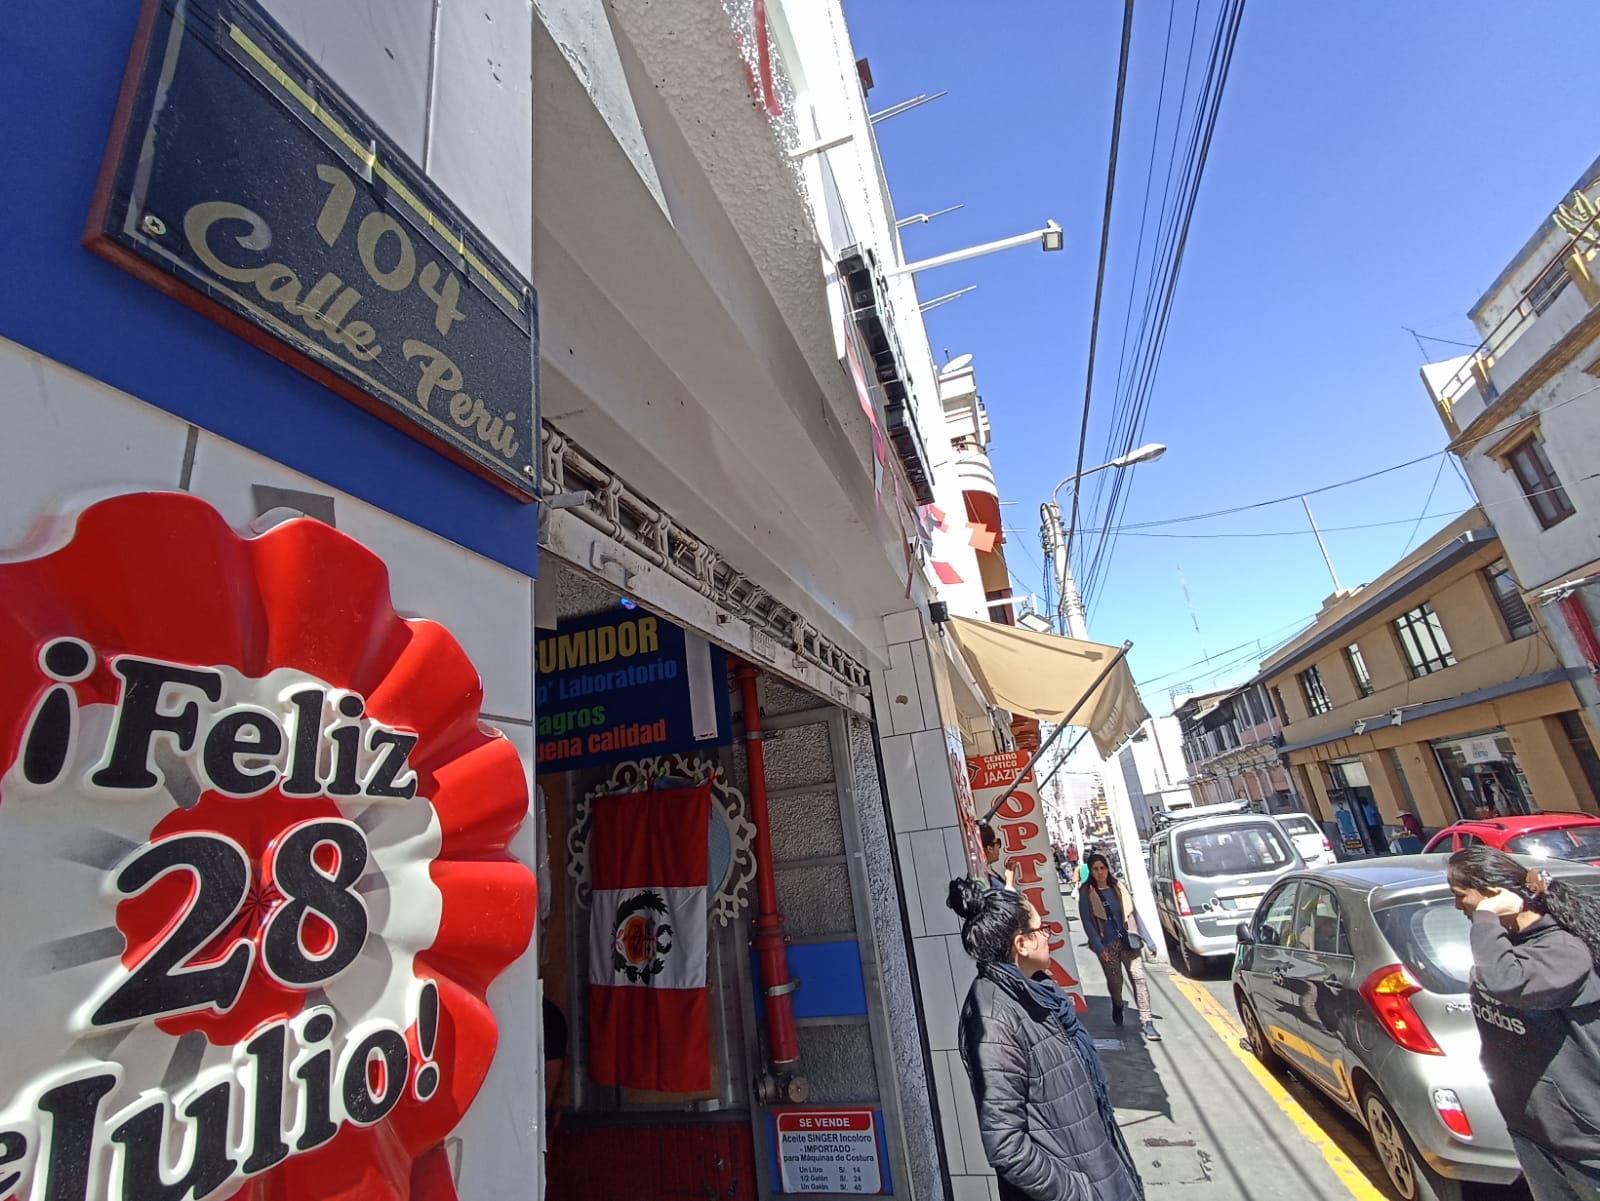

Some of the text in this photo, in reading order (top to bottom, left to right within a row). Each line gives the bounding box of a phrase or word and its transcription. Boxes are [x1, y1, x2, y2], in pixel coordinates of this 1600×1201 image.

[316, 164, 466, 336] 104
[183, 201, 521, 459] Calle Perú
[536, 616, 659, 673] UMIDOR
[560, 658, 678, 701] Laboratorio
[22, 639, 419, 800] ¡Feliz
[537, 705, 607, 736] agros
[588, 718, 667, 754] calidad
[983, 752, 1018, 763] CENTRO
[91, 822, 371, 1026] 28
[1473, 1003, 1526, 1036] adidas
[782, 1133, 872, 1143] Aceite SINGER Incoloro
[799, 1117, 850, 1128] SE VENDE
[783, 1155, 799, 1164] para
[835, 1153, 845, 1162] de
[846, 1153, 874, 1162] Costura
[804, 1144, 851, 1153] IMPORTADO
